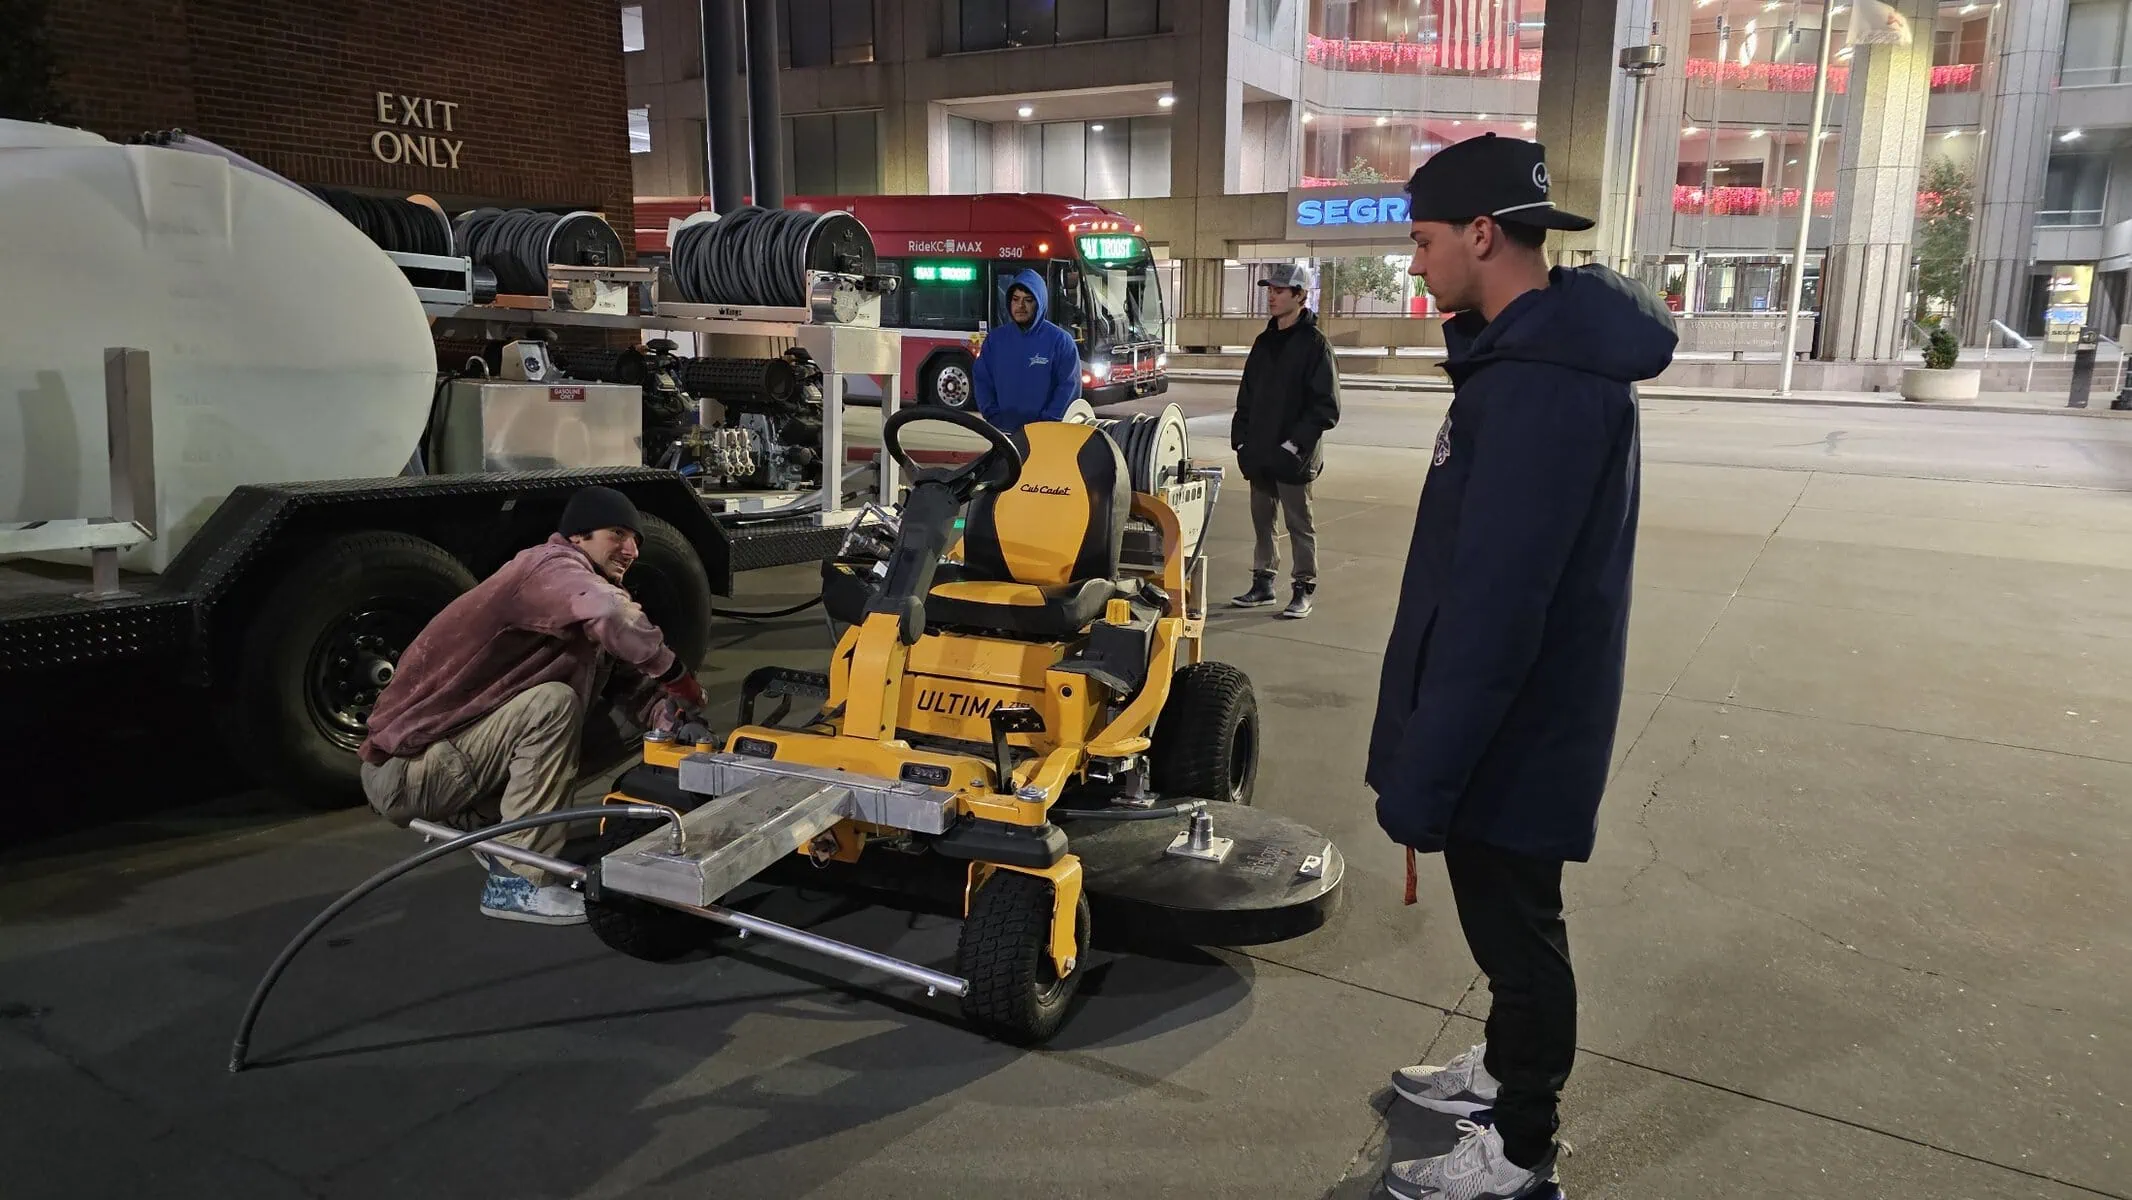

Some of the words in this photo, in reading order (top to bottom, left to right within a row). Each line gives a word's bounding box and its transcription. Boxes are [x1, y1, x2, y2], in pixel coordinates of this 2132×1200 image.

[376, 91, 459, 132] EXIT
[371, 130, 463, 169] ONLY
[1297, 197, 1412, 225] SEGR
[908, 241, 945, 253] RideKC
[956, 242, 982, 253] MAX
[999, 247, 1023, 258] 3540
[1100, 238, 1133, 258] TROOST
[1020, 484, 1039, 492] Cub
[1039, 485, 1071, 496] Cadet
